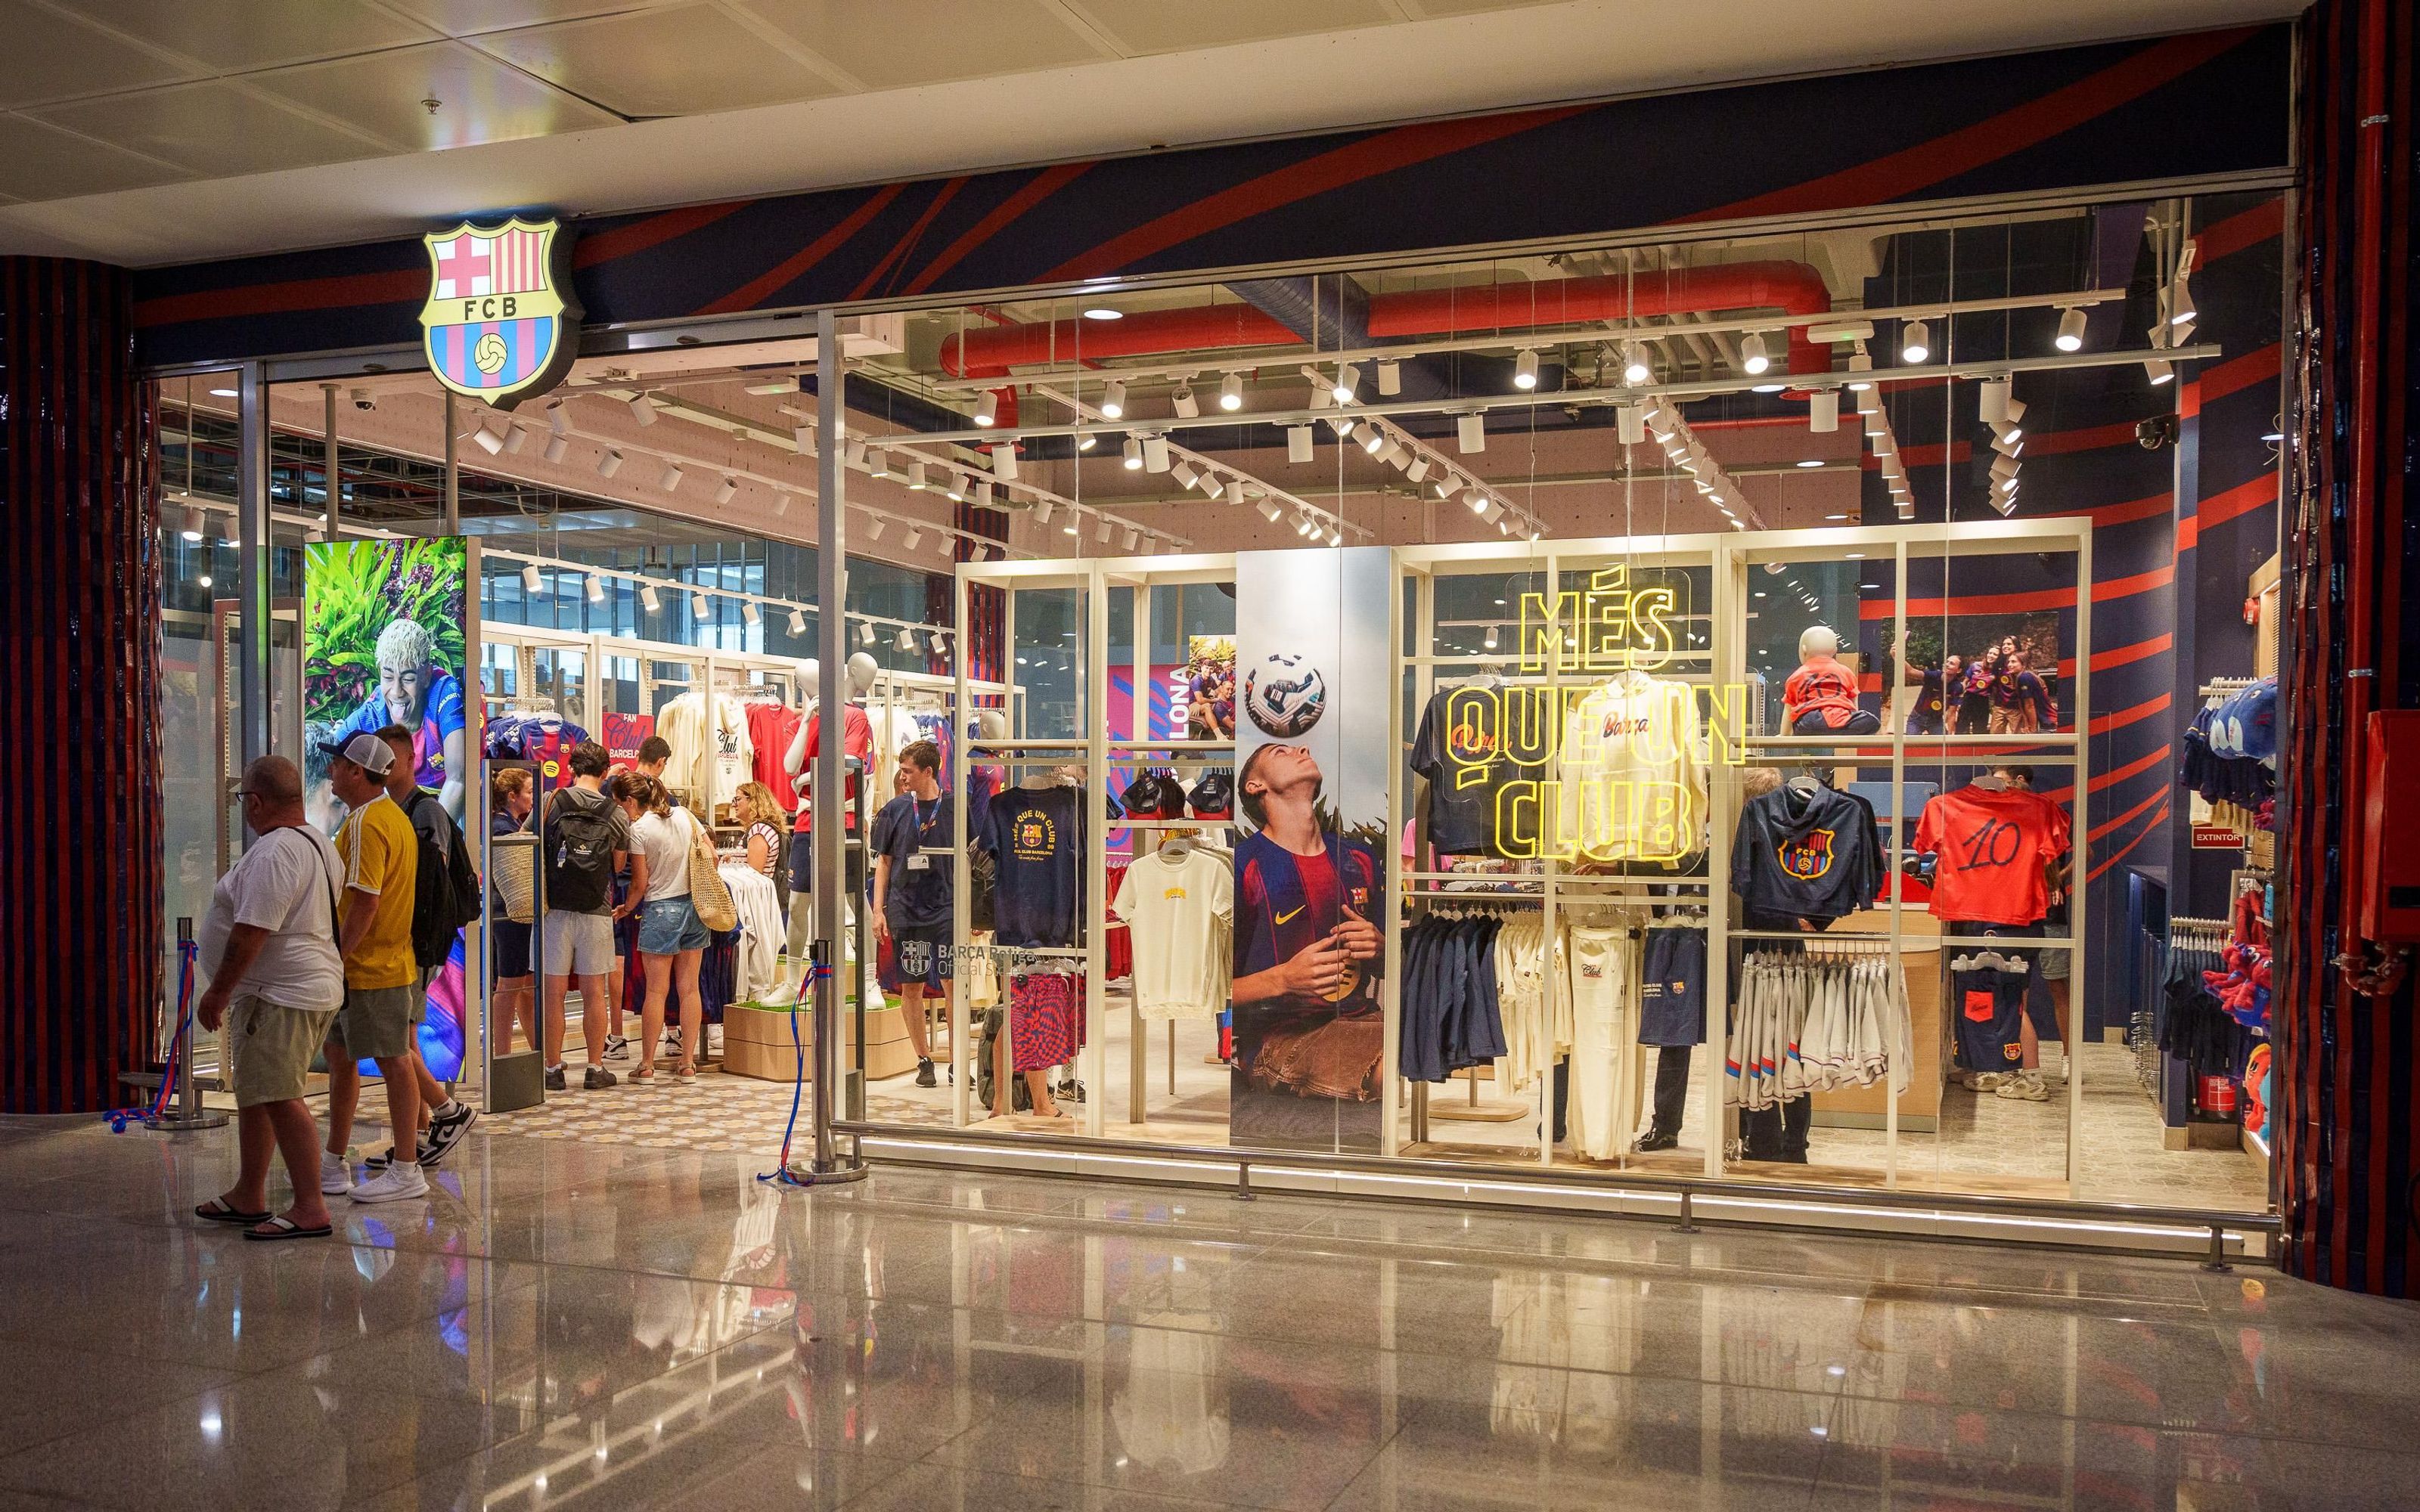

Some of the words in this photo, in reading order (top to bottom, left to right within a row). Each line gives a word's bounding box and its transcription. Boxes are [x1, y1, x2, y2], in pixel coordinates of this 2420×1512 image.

[465, 297, 517, 321] FCB
[1520, 563, 1674, 671] MÉS
[623, 714, 637, 723] FAN
[1602, 711, 1649, 738] Barça
[1446, 686, 1606, 790] QUE
[1630, 684, 1747, 766] UN
[1017, 810, 1033, 823] QUE
[1035, 810, 1047, 820] UN
[1045, 820, 1056, 843] CLUB
[1495, 781, 1691, 861] CLUB
[1796, 847, 1816, 857] FCB
[1957, 817, 2021, 871] 10
[938, 944, 985, 962] BARÇA
